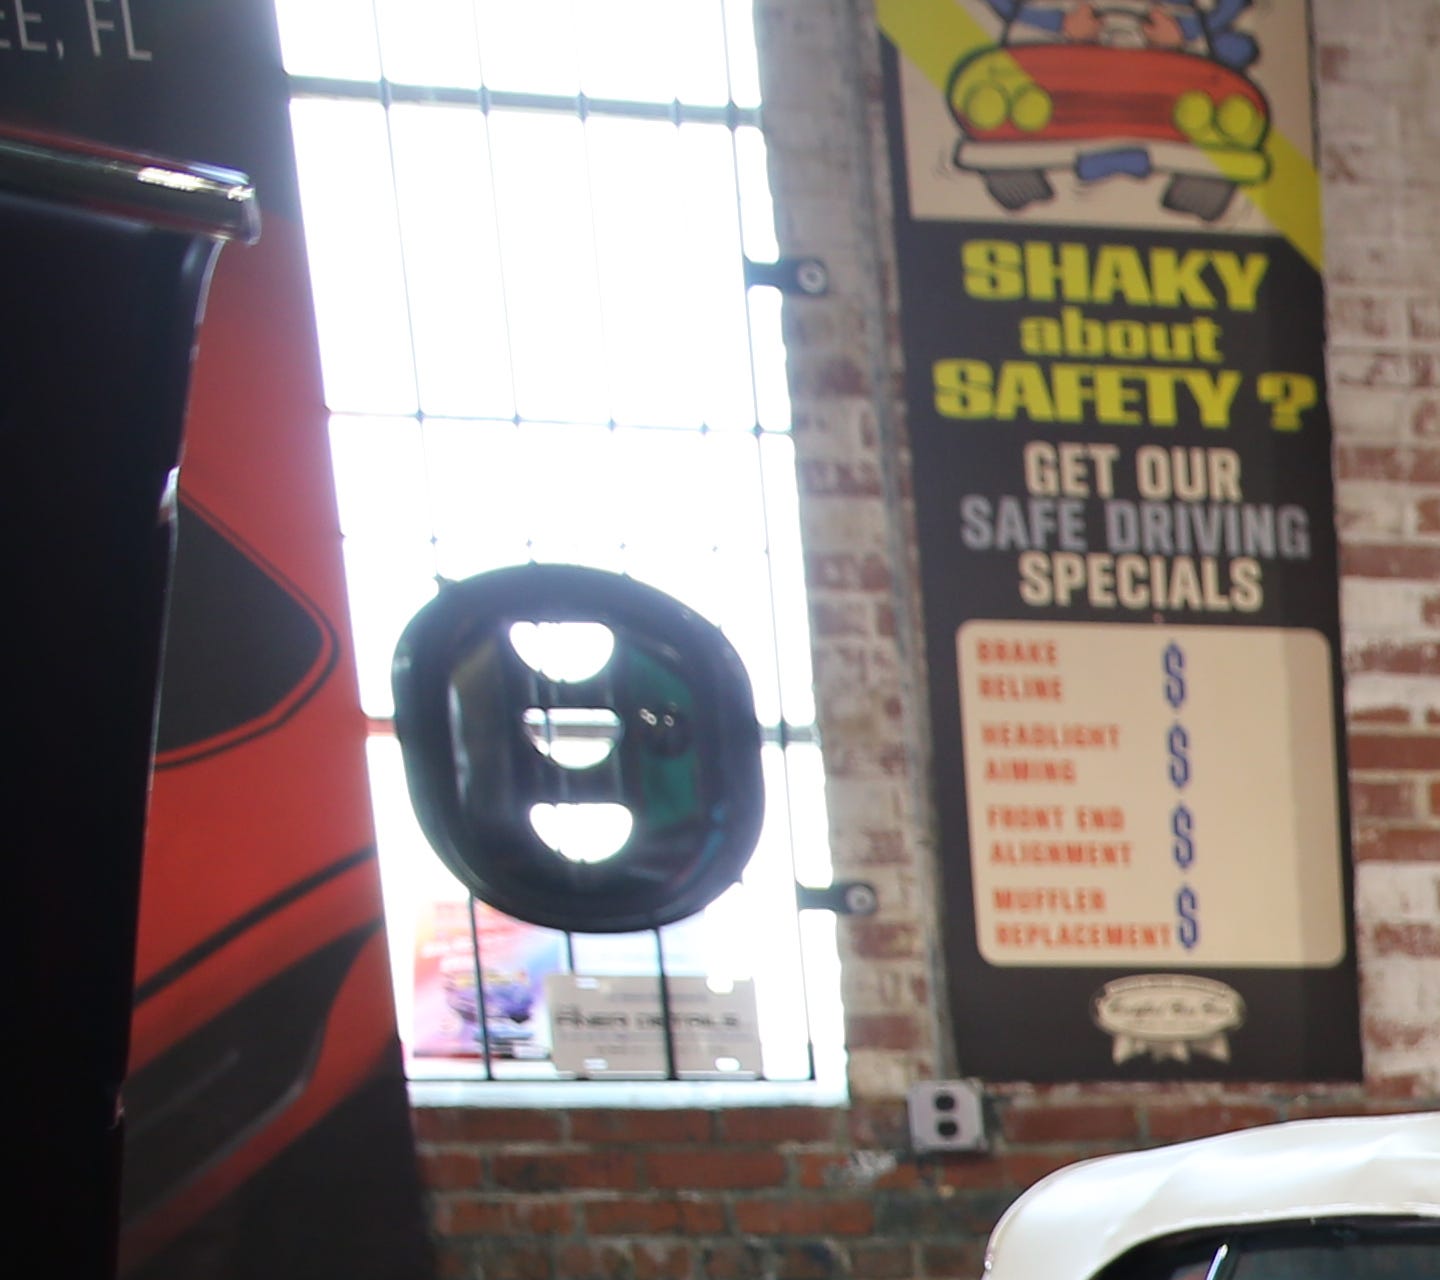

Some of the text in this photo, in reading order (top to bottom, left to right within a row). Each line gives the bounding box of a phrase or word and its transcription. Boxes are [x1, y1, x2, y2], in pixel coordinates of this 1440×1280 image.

[962, 238, 1269, 311] SHAKY
[1020, 307, 1223, 363] about
[933, 359, 1242, 429] SAFETY
[1024, 441, 1242, 502] GET OUR
[961, 494, 1311, 562] SAFE DRIVING
[1019, 551, 1264, 611] SPECIALS
[977, 638, 1058, 666] BRAKE
[979, 674, 1064, 701] RELINE
[982, 722, 1121, 749] HEADLIGHT
[985, 759, 1078, 784] AIMING
[988, 805, 1125, 830] FRONT END
[990, 842, 1133, 867] ALIGNMENT
[993, 887, 1106, 912] MUFFLER
[997, 922, 1172, 949] REPLACEMENT
